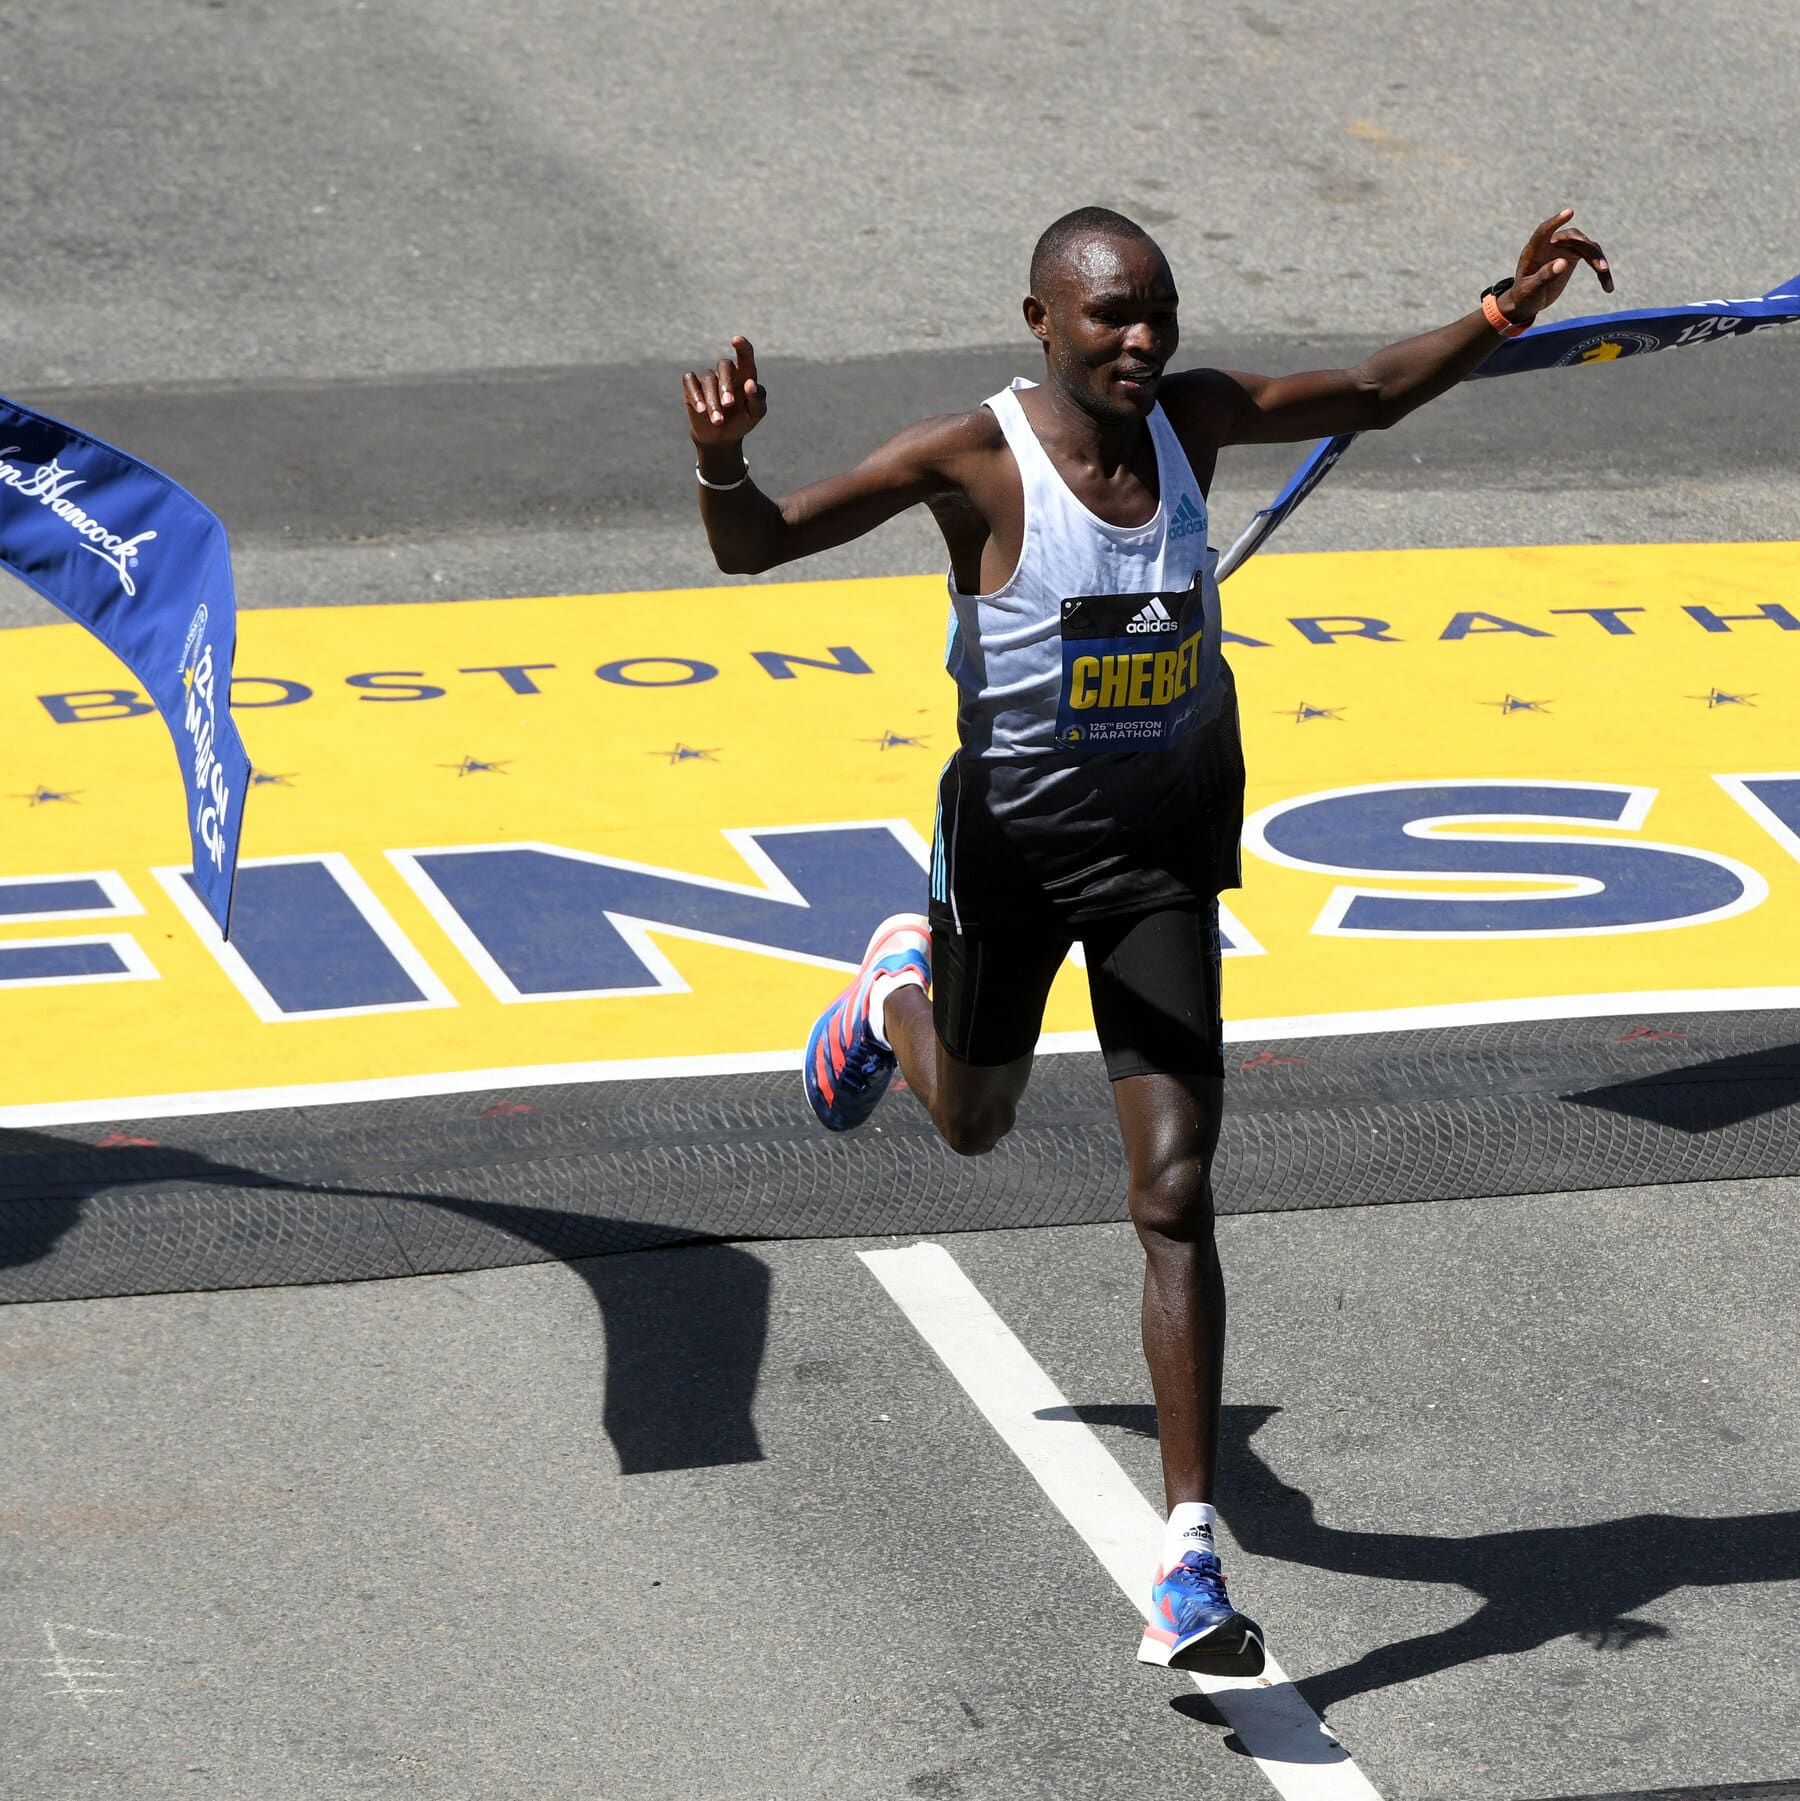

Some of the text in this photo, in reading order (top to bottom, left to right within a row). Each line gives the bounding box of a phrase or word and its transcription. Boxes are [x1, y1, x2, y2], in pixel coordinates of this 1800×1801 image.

[16, 458, 158, 597] Hancock
[1169, 519, 1207, 540] adidas
[1126, 619, 1178, 634] adidas
[1069, 629, 1203, 710] CHEBET
[37, 646, 874, 725] BOSTON
[1089, 721, 1162, 731] 126TH BOSTON
[1089, 730, 1161, 740] MARATHON
